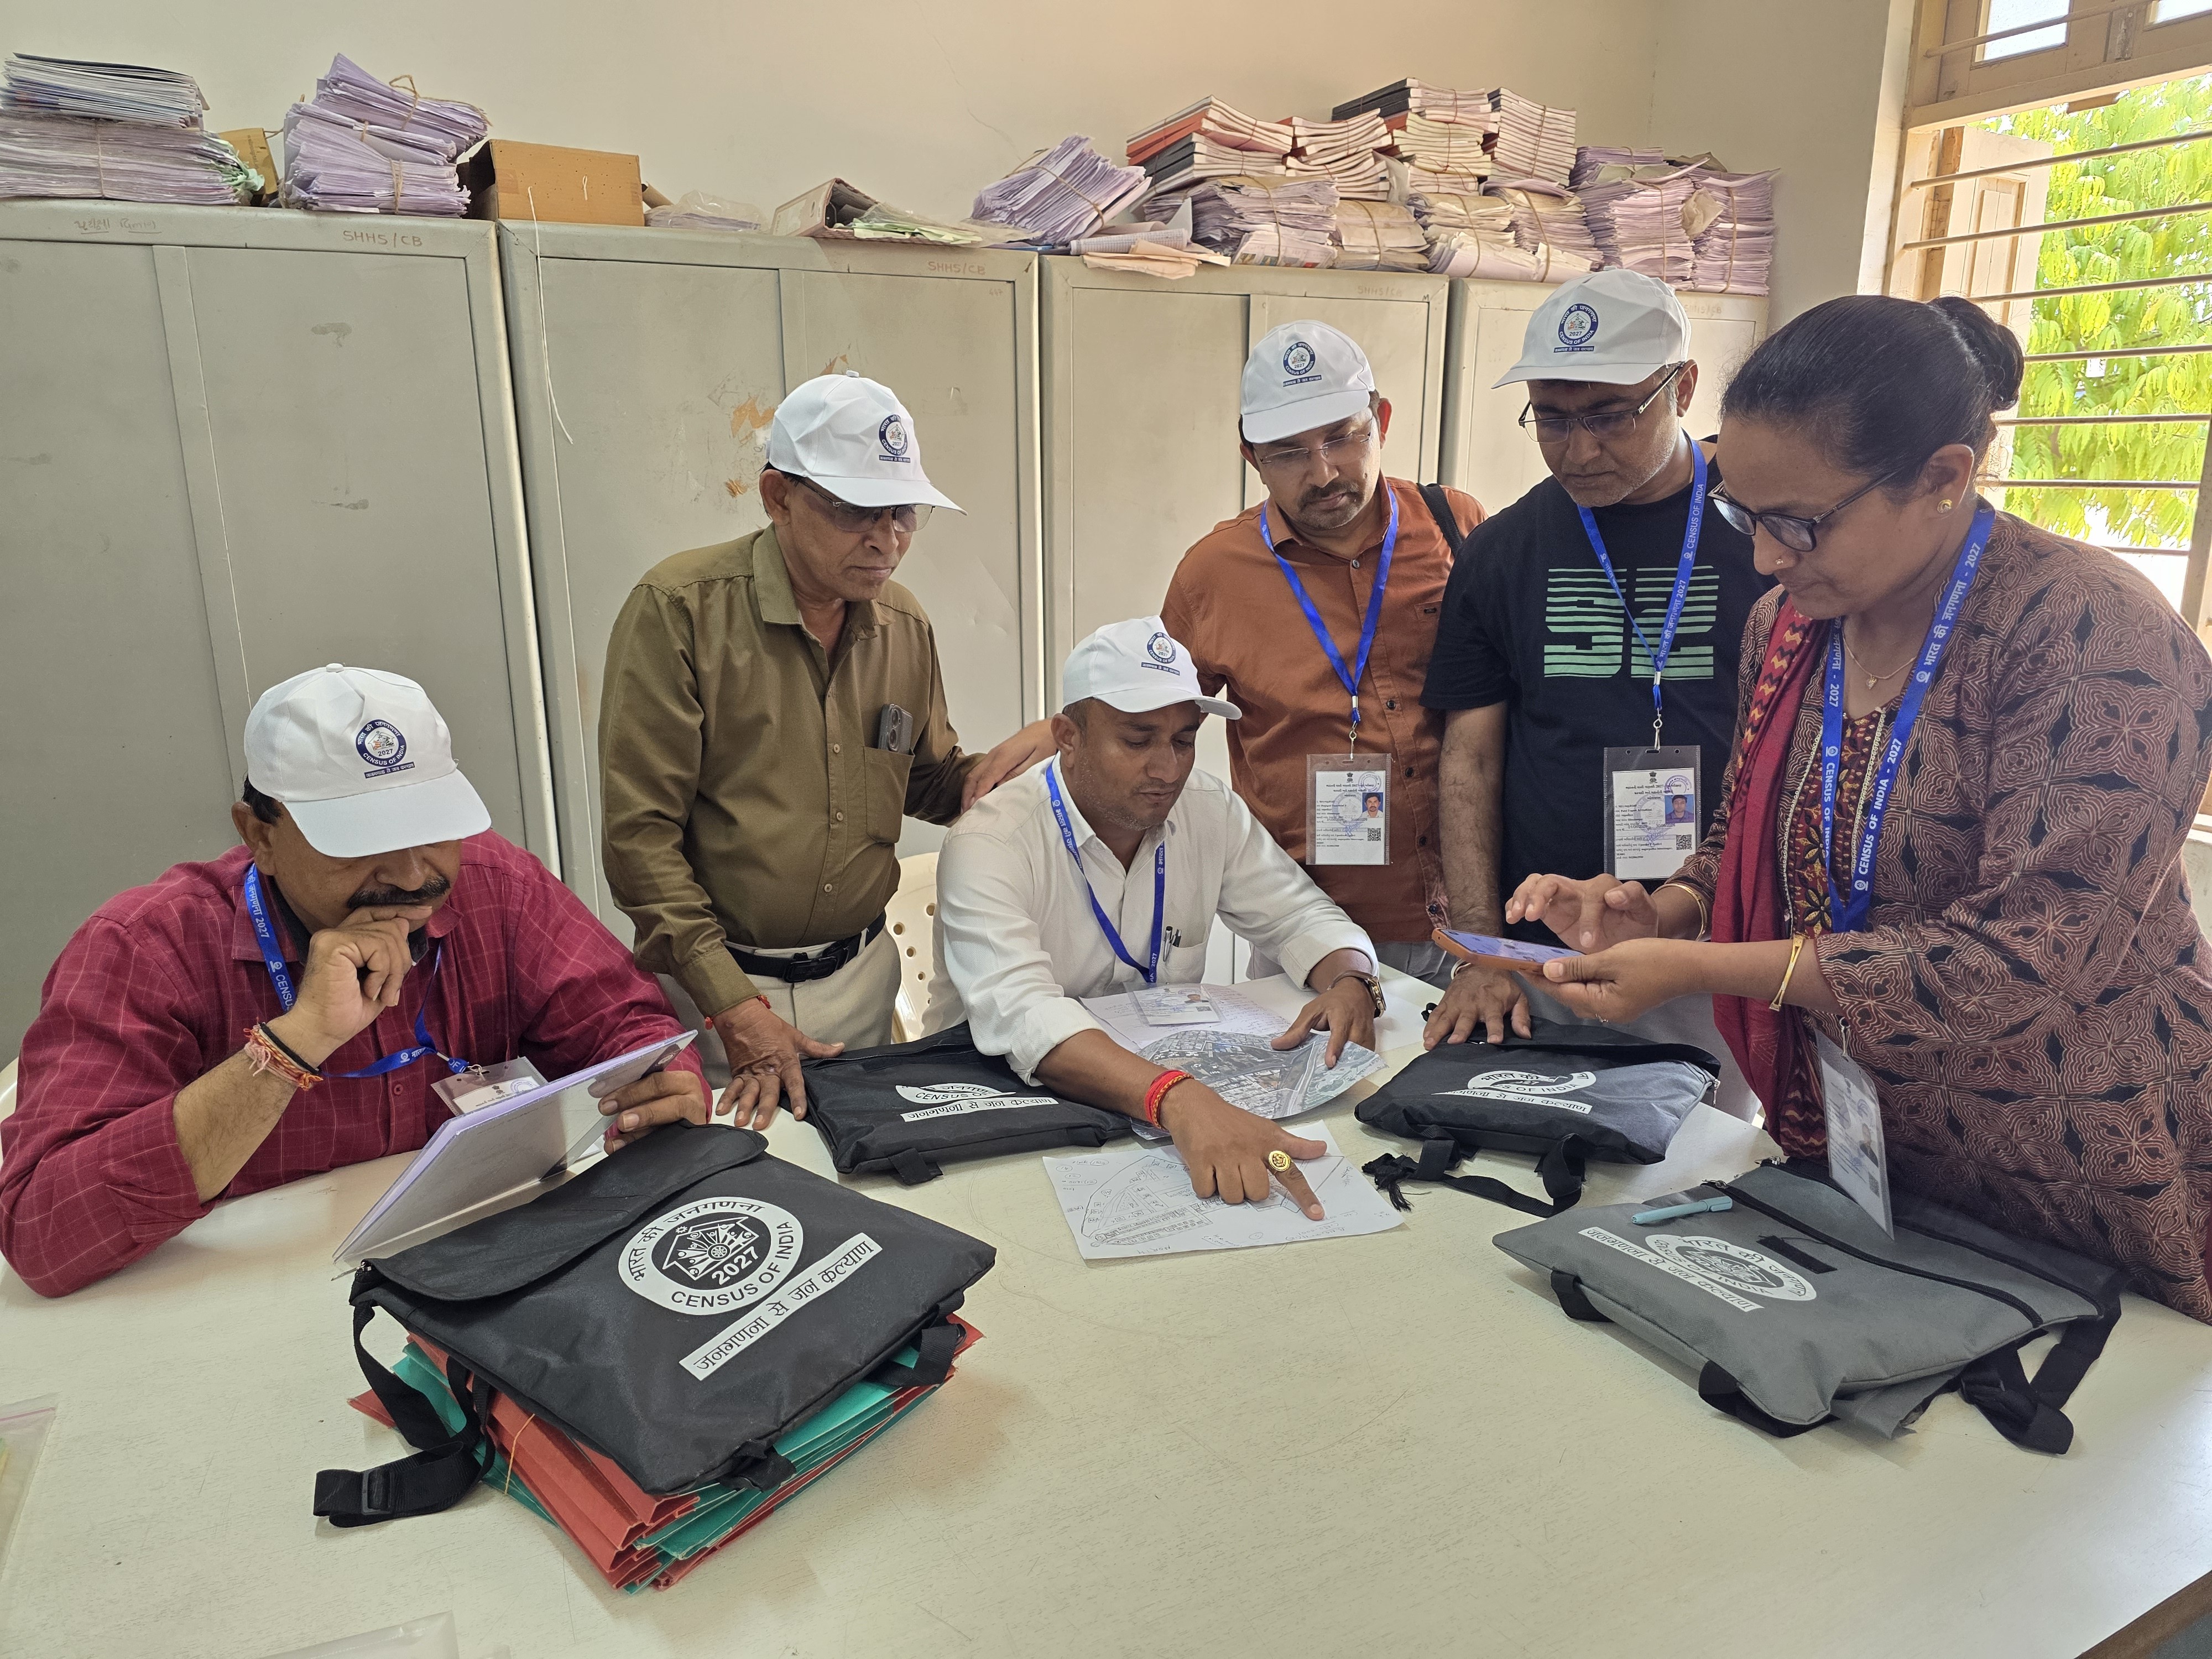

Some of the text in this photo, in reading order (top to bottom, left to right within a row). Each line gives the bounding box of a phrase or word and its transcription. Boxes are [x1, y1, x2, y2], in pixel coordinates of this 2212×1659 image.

[1559, 331, 1573, 345] CENSUS
[1582, 330, 1594, 342] INDIA
[881, 439, 896, 454] CENSUS
[1687, 484, 1704, 549] CENSUS OF INDIA
[1676, 580, 1687, 598] 2027
[1923, 642, 1942, 666] भारत
[1933, 624, 1949, 639] की
[1942, 580, 1967, 620] जनगणना
[1965, 542, 1981, 568] 2027
[1829, 684, 1840, 707] 2027
[363, 753, 387, 765] CENSUS
[397, 745, 405, 760] INDIA
[1824, 762, 1835, 802] CENSUS
[1824, 807, 1830, 822] OF
[1858, 833, 1875, 875] CENSUS
[1869, 813, 1879, 830] OF
[1874, 779, 1889, 810] INDIA
[1887, 738, 1902, 764] 2027
[1056, 808, 1066, 827] भारत
[1063, 827, 1071, 837] की
[255, 916, 270, 938] 2027
[1481, 1073, 1516, 1082] भारत
[1542, 1083, 1580, 1092] INDIA
[907, 1104, 963, 1118] जनगणना
[967, 1100, 979, 1109] से
[1541, 1099, 1588, 1112] कल्याण
[629, 1202, 766, 1281] भारत की जनगणना
[671, 1221, 794, 1308] CENSUS OF INDIA
[711, 1246, 759, 1285] 2027
[1587, 1228, 1647, 1259] जनगणना
[1668, 1266, 1697, 1280] जन
[1698, 1280, 1756, 1310] कल्याण
[1739, 1251, 1766, 1262] की
[1769, 1264, 1807, 1297] जनगणना
[1687, 1264, 1713, 1275] OF
[1719, 1276, 1774, 1295] INDIA
[693, 1240, 874, 1370] जनगणना से जन कल्याण
